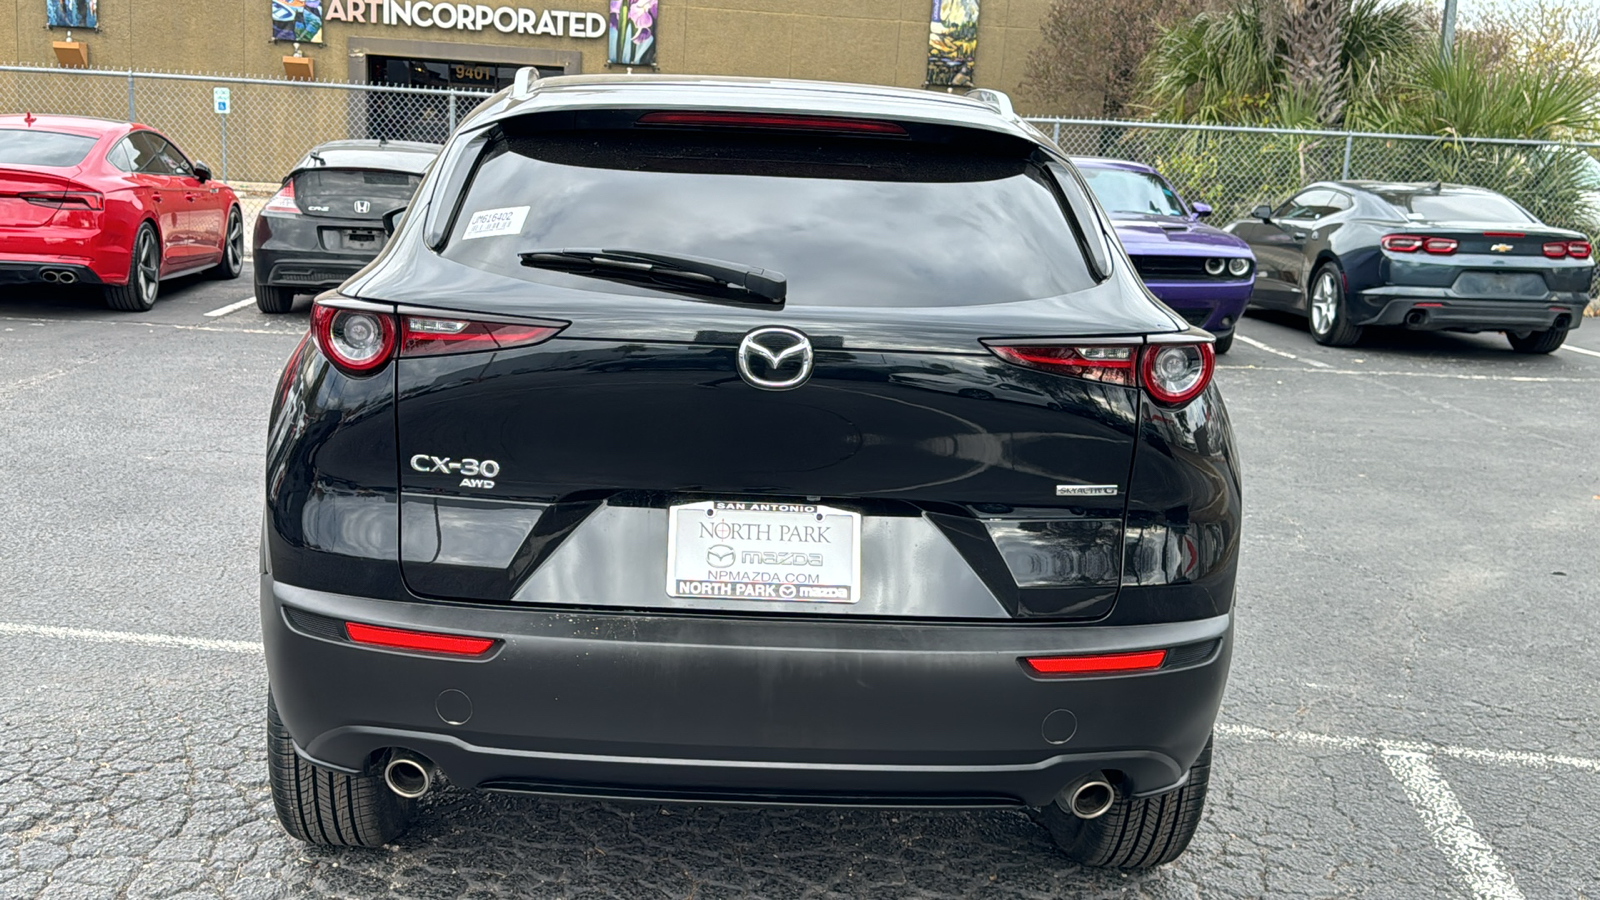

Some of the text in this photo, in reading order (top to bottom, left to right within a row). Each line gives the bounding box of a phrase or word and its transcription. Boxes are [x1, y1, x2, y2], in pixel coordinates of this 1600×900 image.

[456, 66, 491, 81] 9401
[410, 453, 500, 478] CX-30
[459, 478, 495, 489] AWD
[716, 502, 815, 513] SAN ANTONIO
[699, 521, 831, 543] NORTH PARK
[708, 570, 820, 584] NPMAZDA.COM
[679, 582, 732, 596] NORTH
[736, 584, 776, 598] PARK
